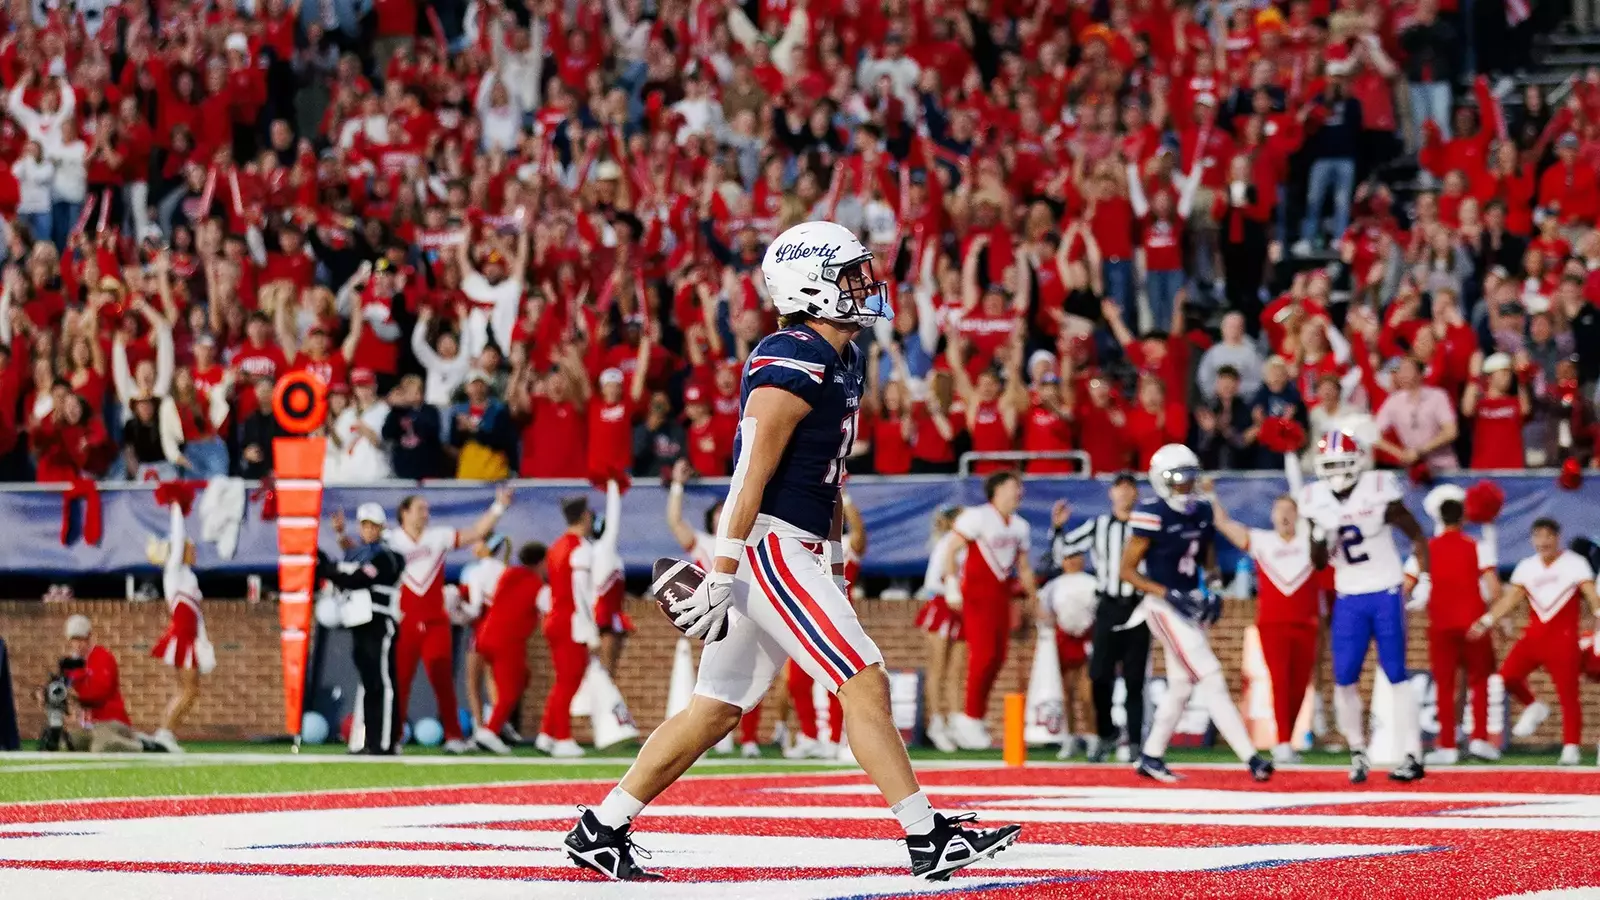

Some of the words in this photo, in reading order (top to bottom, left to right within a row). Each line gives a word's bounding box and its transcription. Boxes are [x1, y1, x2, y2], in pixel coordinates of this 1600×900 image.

[776, 242, 841, 267] Liberty
[821, 409, 860, 487] 1
[1338, 524, 1370, 565] 2
